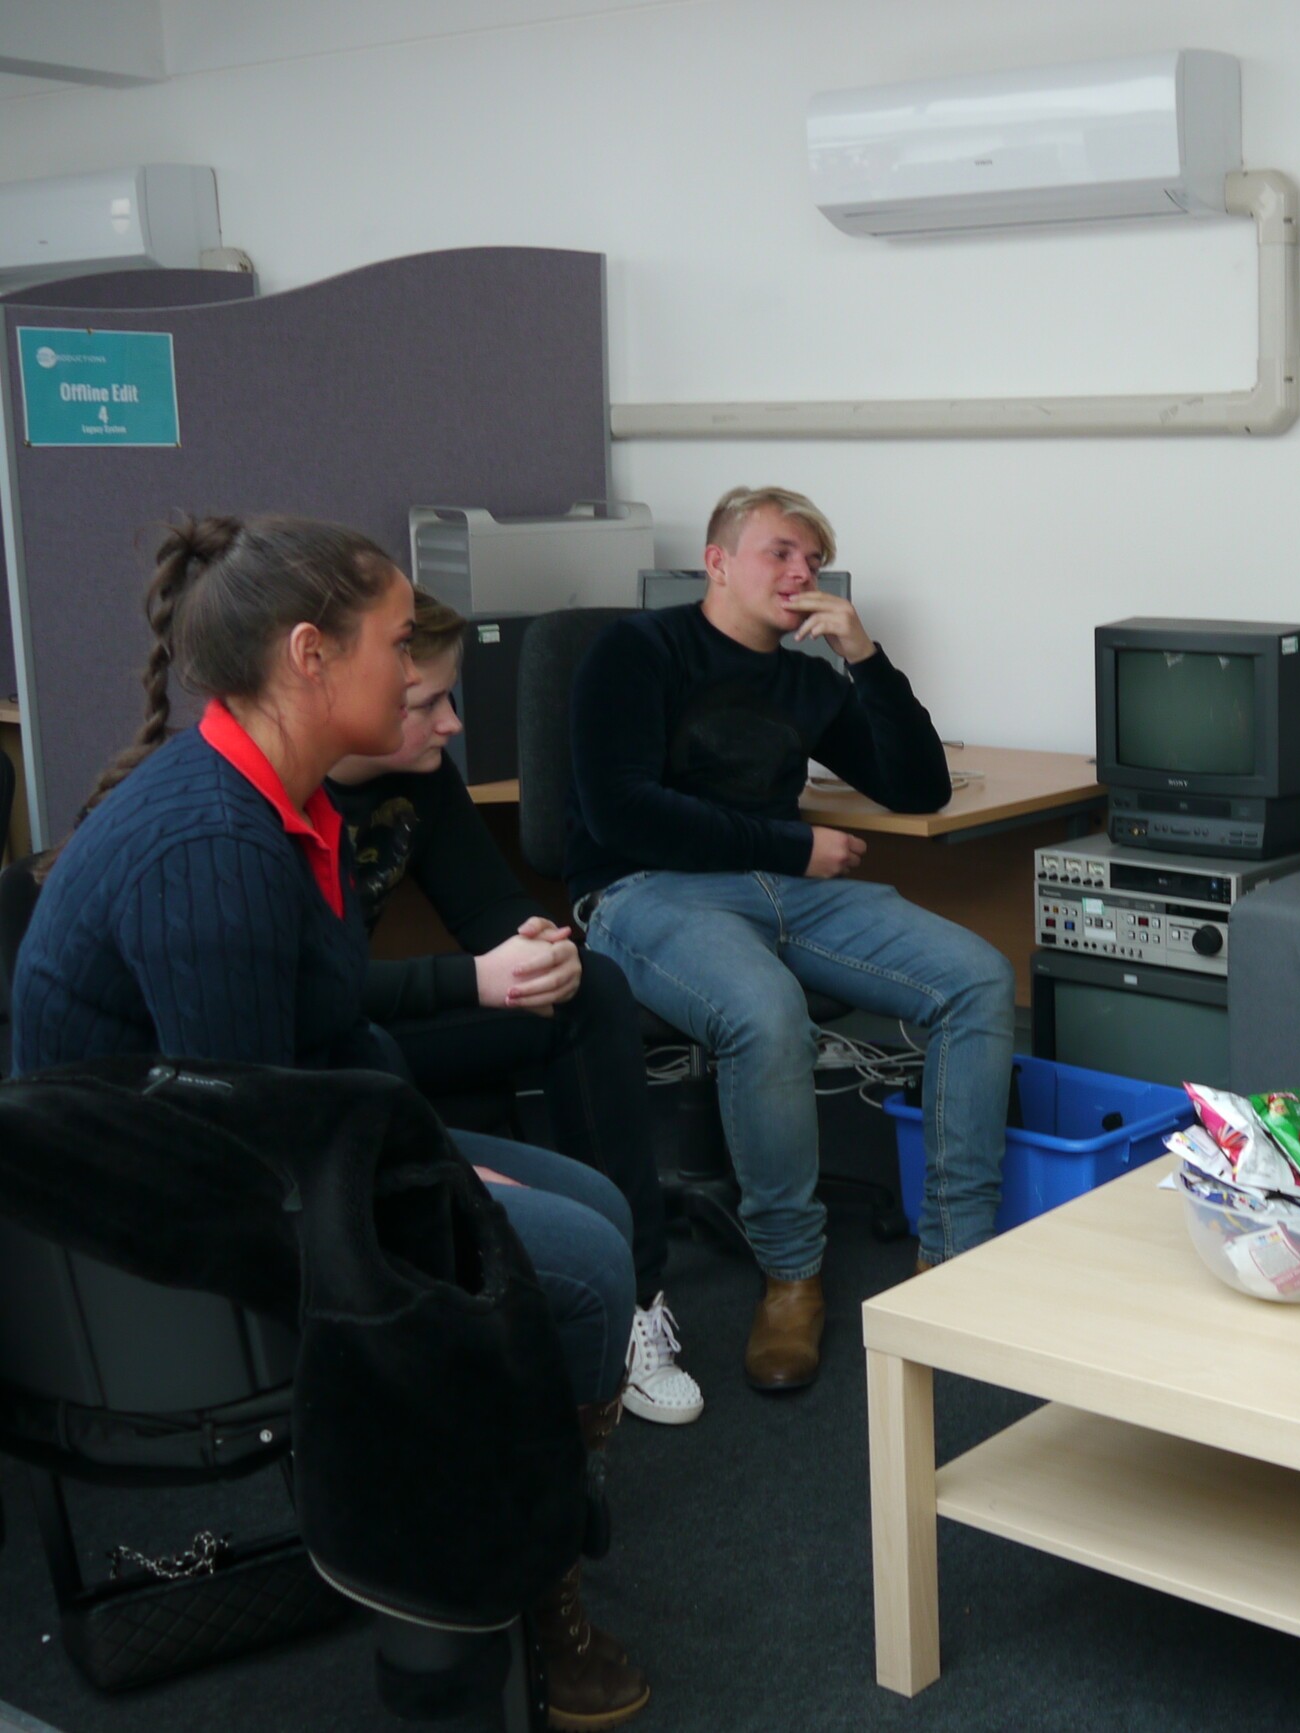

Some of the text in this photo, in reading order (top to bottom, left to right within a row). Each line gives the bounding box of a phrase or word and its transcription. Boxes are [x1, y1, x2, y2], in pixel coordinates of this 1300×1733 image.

[60, 382, 139, 402] Offline Edit
[98, 405, 109, 424] 4
